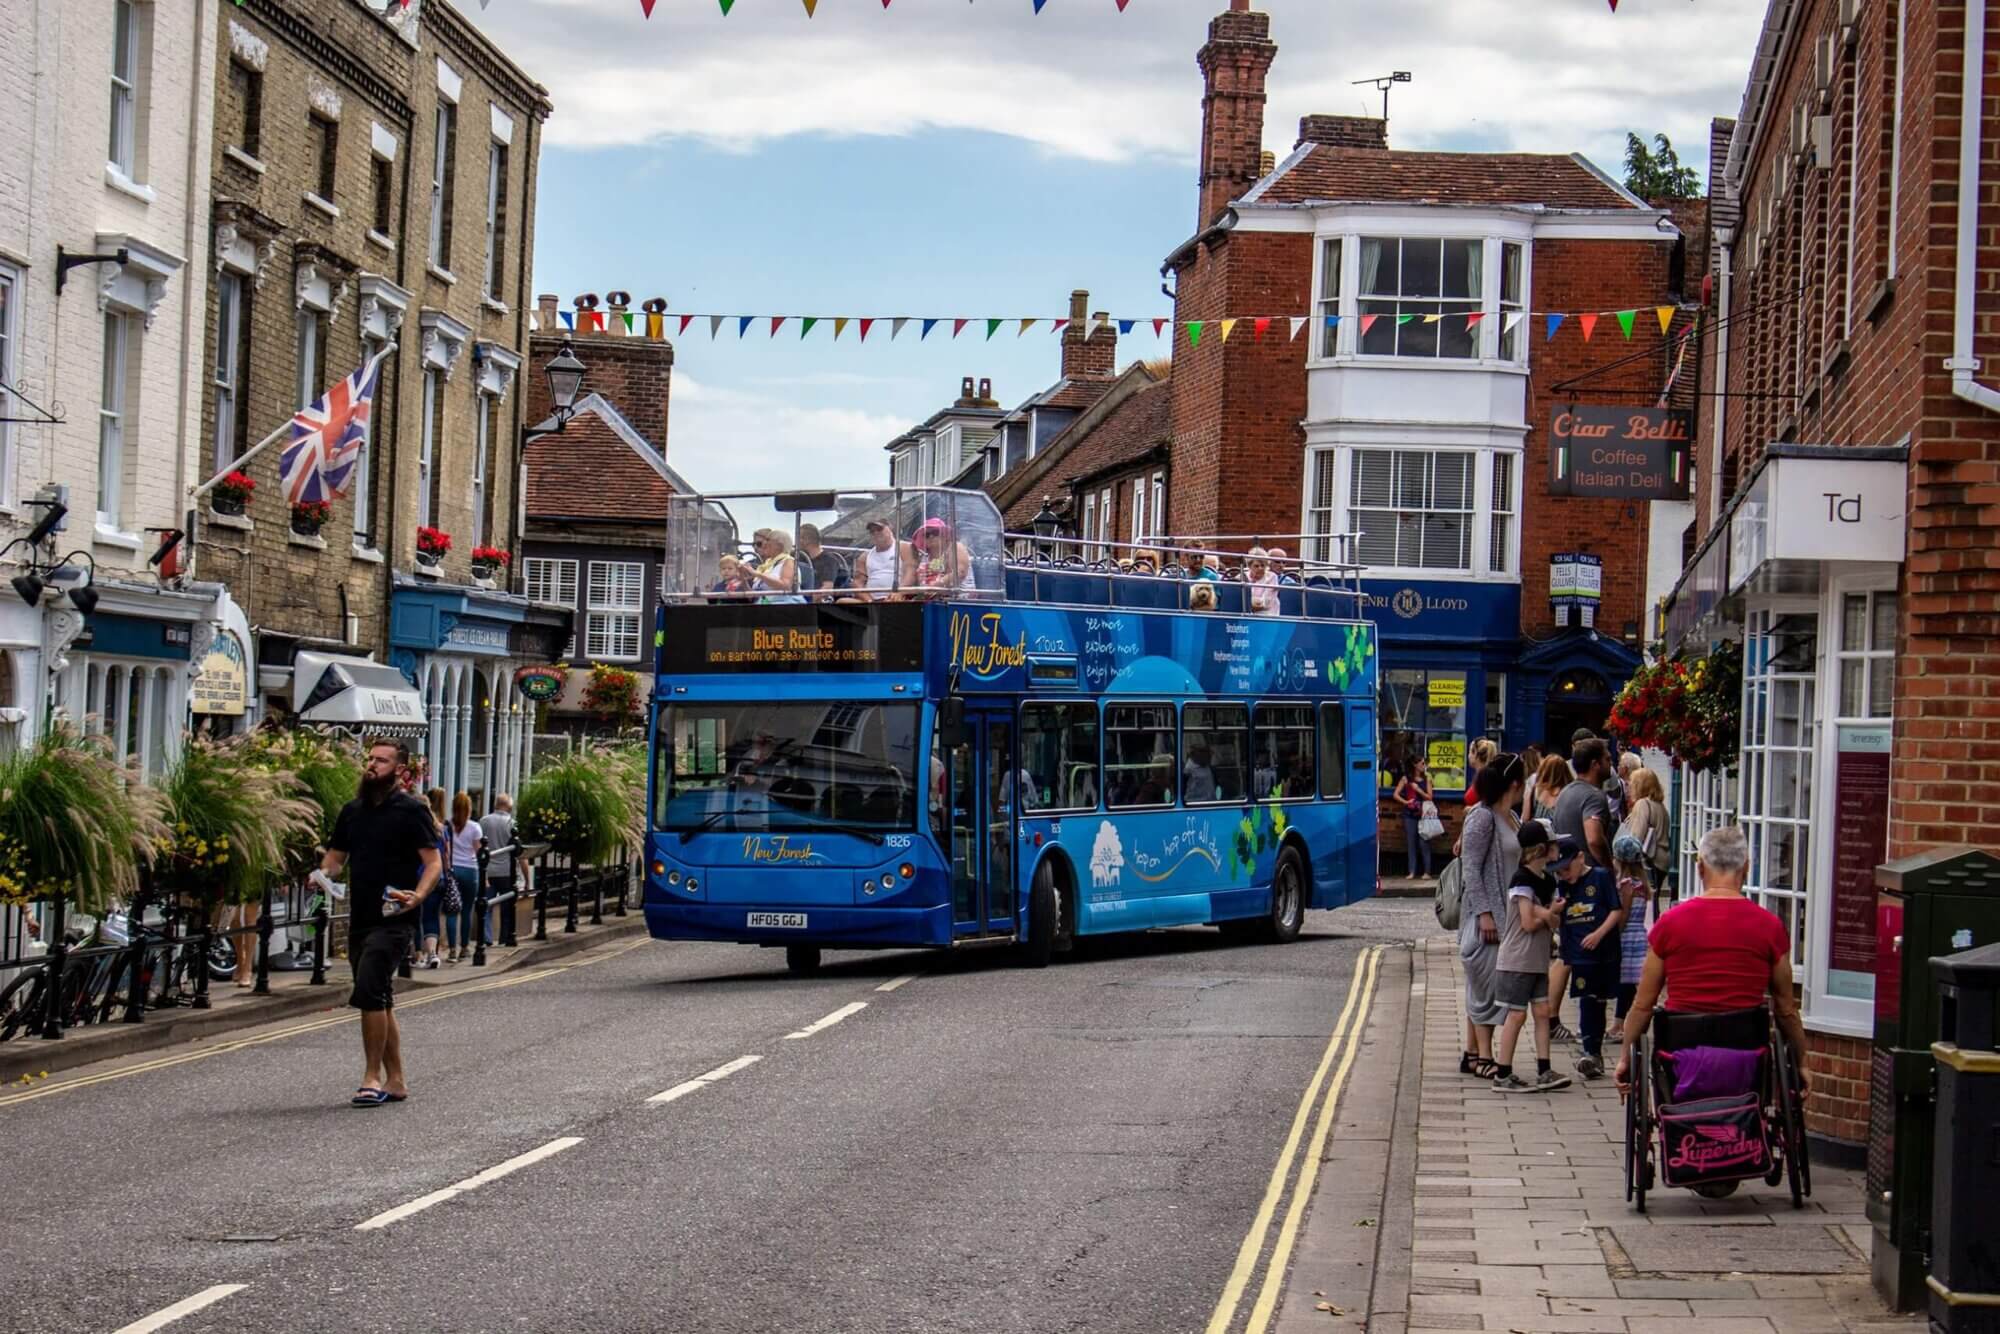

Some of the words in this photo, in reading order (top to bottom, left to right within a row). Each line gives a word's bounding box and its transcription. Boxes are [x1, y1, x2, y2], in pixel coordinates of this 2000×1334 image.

[1553, 412, 1615, 438] Ciao
[1621, 415, 1688, 440] Belli
[1591, 448, 1647, 465] Coffee
[1575, 470, 1624, 487] Italian
[1630, 471, 1662, 488] Deli
[1823, 493, 1861, 522] Td
[1426, 596, 1468, 610] LLOYD
[1101, 619, 1124, 632] more
[753, 629, 784, 650] Blue
[789, 628, 834, 650] Route
[950, 610, 985, 672] New
[978, 613, 1026, 674] Forest
[766, 651, 778, 661] on
[842, 650, 855, 660] on
[1118, 643, 1140, 655] more
[1438, 697, 1462, 705] DECKS
[1436, 745, 1458, 755] 70%
[1437, 758, 1457, 767] OFF
[886, 835, 911, 848] 1826
[1163, 835, 1180, 857] hop
[1182, 816, 1196, 846] off
[1199, 819, 1209, 845] all
[743, 835, 773, 861] New
[771, 836, 812, 862] Forest
[751, 914, 779, 926] HF05
[782, 915, 804, 926] GGJ
[1669, 1127, 1763, 1173] Superdry
